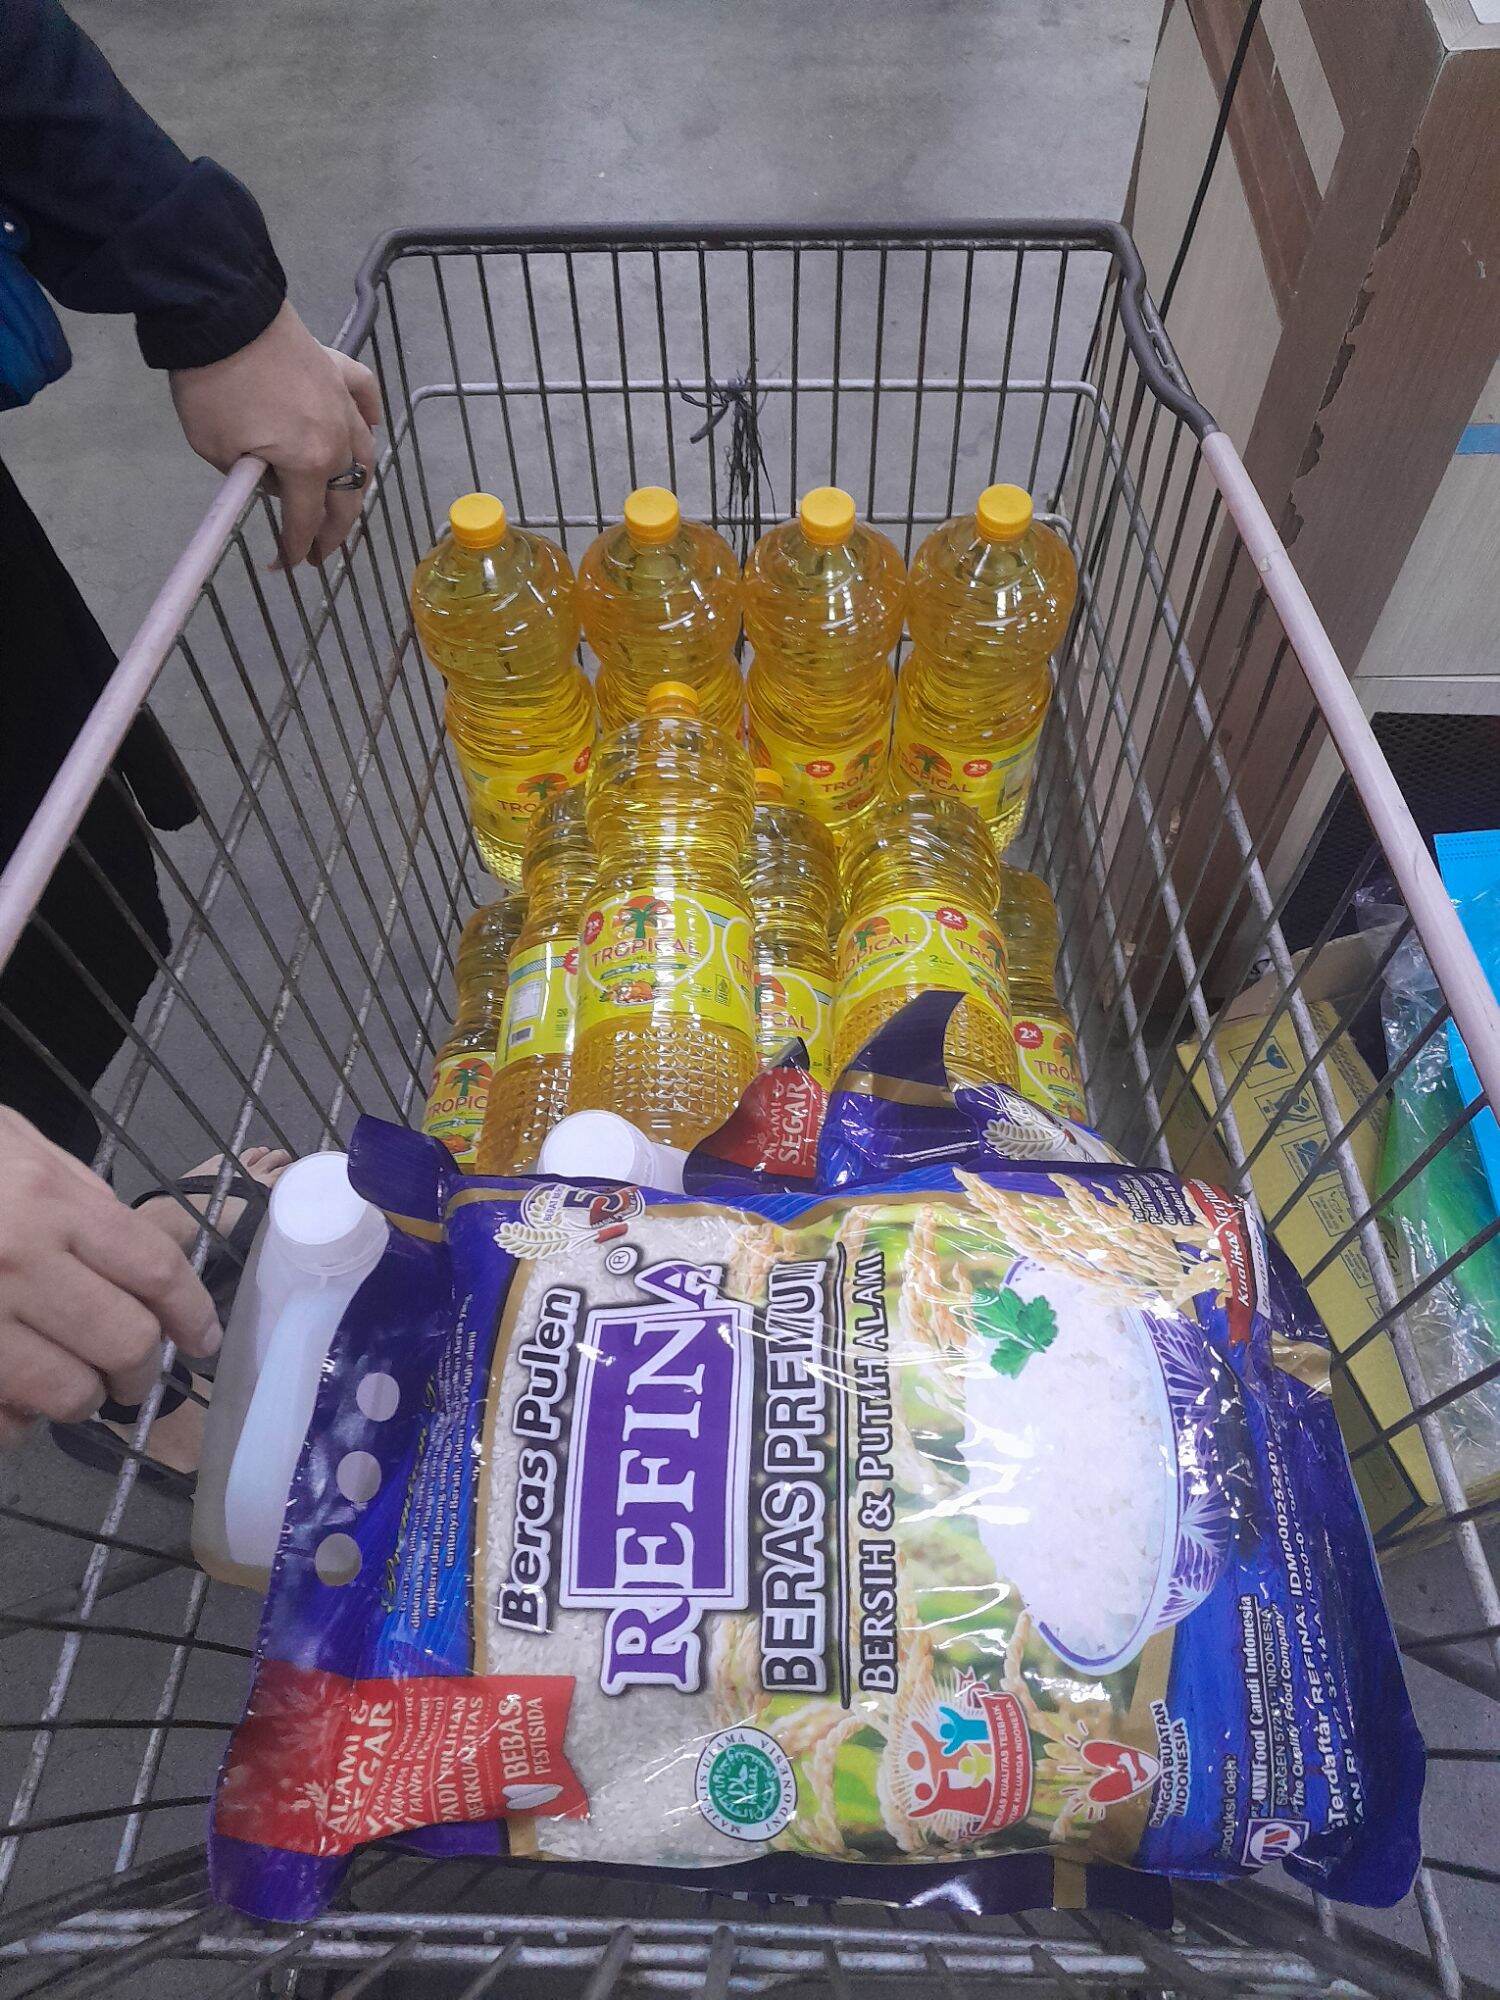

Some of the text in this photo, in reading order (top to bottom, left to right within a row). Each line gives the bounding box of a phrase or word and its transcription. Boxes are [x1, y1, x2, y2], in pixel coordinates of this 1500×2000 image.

[943, 911, 962, 923] 2x
[1018, 1027, 1039, 1040] 2x
[763, 1102, 782, 1160] ALAMI
[779, 1082, 808, 1164] SEGAR
[1145, 1203, 1161, 1224] Padi
[1153, 1188, 1176, 1225] diproses
[1171, 1192, 1192, 1226] modern
[1224, 1230, 1249, 1307] Kualitas
[499, 1290, 579, 1632] Beras Pulen
[603, 1261, 720, 1694] REFINA
[853, 1253, 896, 1694] BERSIH & PUTIH ALAMI
[444, 1512, 459, 1568] tentunya
[1266, 1440, 1303, 1596] IDM000252401
[426, 1567, 438, 1618] modern
[764, 1482, 824, 1691] BERAS
[1239, 1596, 1258, 1673] Indonesia
[1260, 1609, 1277, 1688] INDONESIA
[1295, 1603, 1323, 1704] REFINA:
[991, 1704, 1008, 1748] TERBAIK
[1005, 1701, 1023, 1752] INDONESIA
[1246, 1678, 1264, 1725] Candi
[1280, 1682, 1295, 1721] Food
[498, 1697, 530, 1780] BEBAS
[526, 1697, 552, 1775] PESTISIDA
[1150, 1703, 1174, 1826] BANGGA BUATAN
[1286, 1723, 1304, 1777] Quality
[1315, 1710, 1346, 1823] Terdaftar
[326, 1735, 361, 1834] ALAMI
[348, 1700, 394, 1835] SEGAR
[408, 1765, 425, 1814] TANPA
[999, 1750, 1009, 1797] KUALITAS
[1012, 1752, 1024, 1802] KELUARGA
[1172, 1722, 1188, 1816] INDONESIA
[1274, 1744, 1289, 1806] SRAGEN
[437, 1782, 463, 1822] PADI
